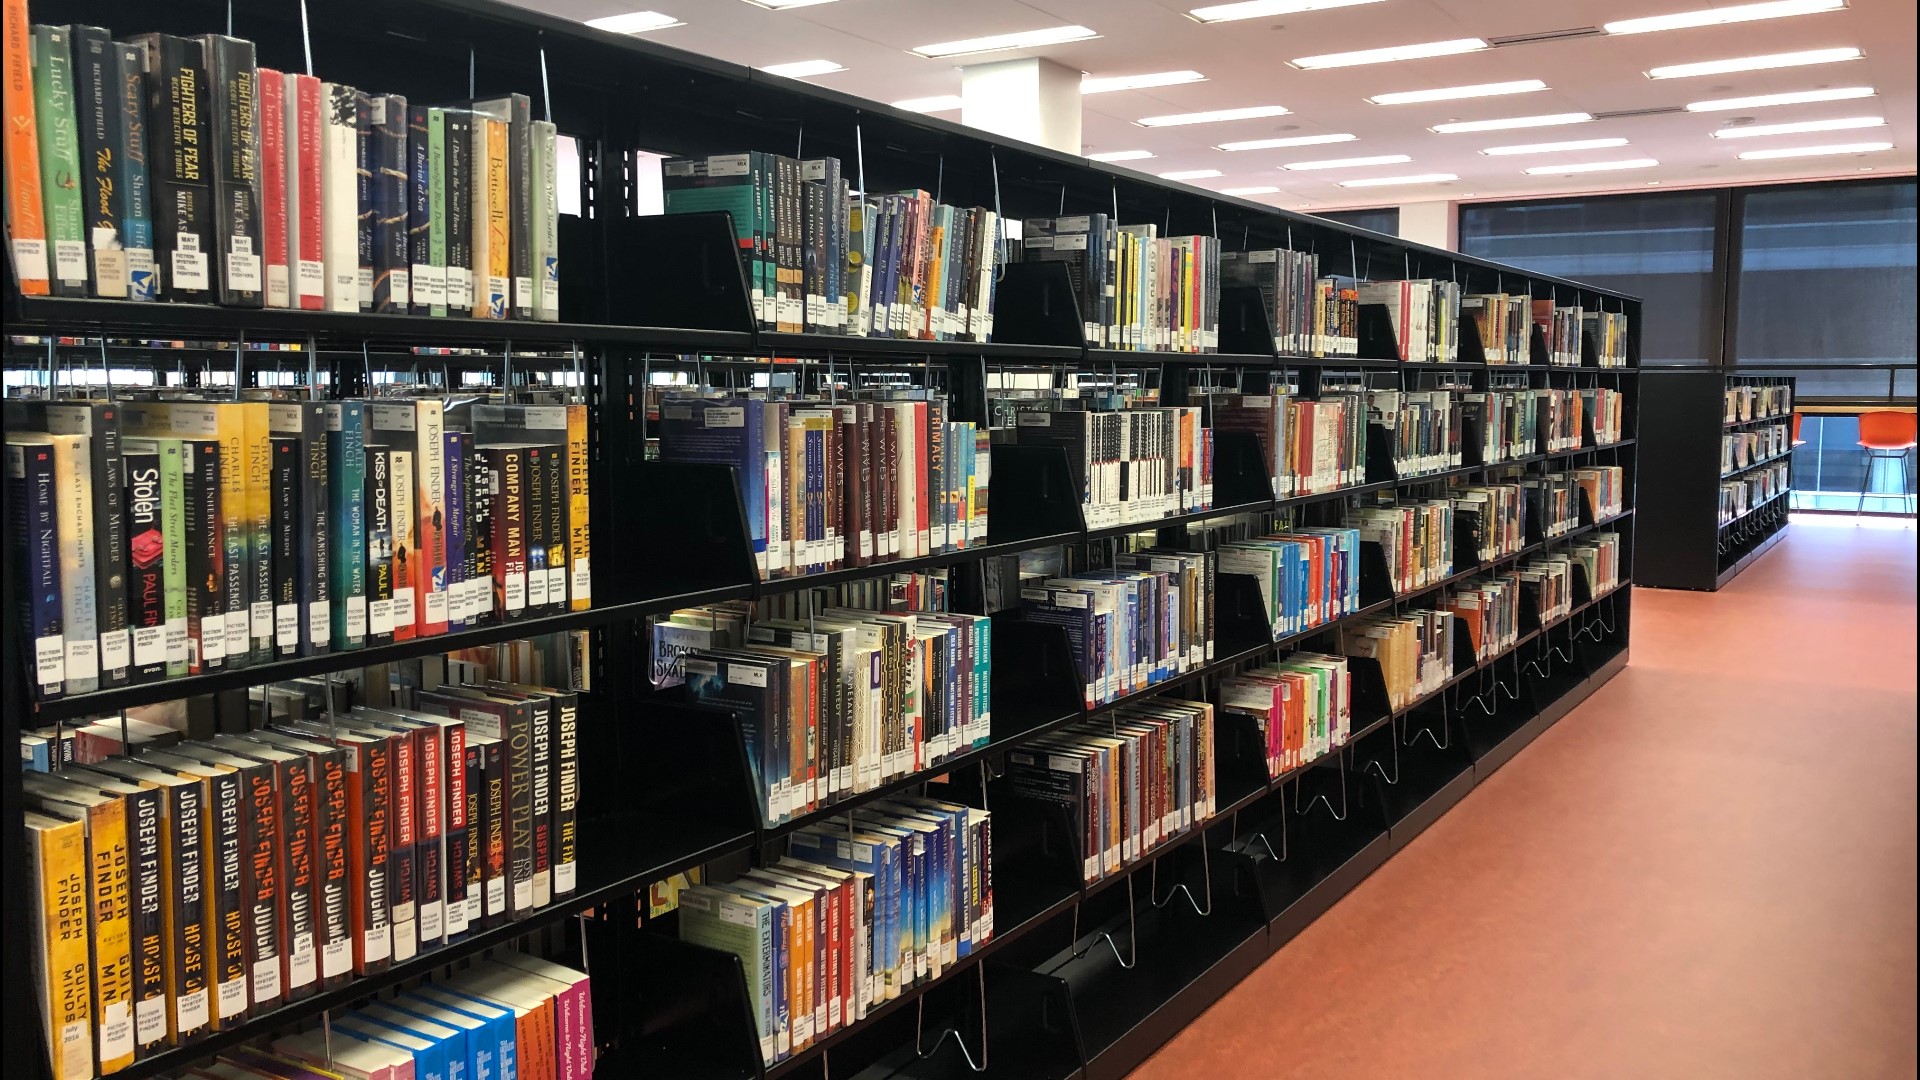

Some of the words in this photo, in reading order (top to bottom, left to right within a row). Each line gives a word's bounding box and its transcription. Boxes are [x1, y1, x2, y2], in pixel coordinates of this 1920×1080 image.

[8, 5, 20, 49] RICHARD
[12, 53, 24, 92] FIFIELD
[49, 55, 68, 113] Lucky
[92, 62, 102, 103] RICHARD
[171, 76, 179, 104] OCCULT
[123, 73, 141, 117] Scary
[180, 67, 197, 125] FIGHTERS
[238, 71, 251, 127] FIGHTERS
[53, 117, 73, 164] Stuff
[128, 121, 145, 165] Stuff
[173, 106, 182, 146] DETECTIVE
[183, 128, 198, 144] OF
[266, 107, 275, 148] beauty
[303, 108, 312, 153] beauty
[96, 147, 112, 171] The
[174, 150, 183, 179] STORIES
[184, 147, 199, 180] FEAR
[241, 148, 254, 181] FEAR
[417, 152, 425, 182] Burial
[97, 177, 114, 216] Flood
[132, 174, 144, 217] Sharon
[177, 190, 187, 217] MIKE
[234, 190, 244, 216] MIKE
[491, 157, 504, 222] Botticelli
[434, 211, 442, 235] Death
[105, 429, 116, 450] THE
[345, 430, 354, 467] FINCH
[427, 424, 439, 461] JOSEPH
[931, 407, 943, 472] PRIMACY
[106, 458, 118, 488] LAWS
[169, 471, 178, 487] The
[205, 461, 214, 482] THE
[220, 446, 230, 485] FINCH
[230, 437, 241, 493] CHARLES
[251, 445, 261, 484] FINCH
[310, 441, 319, 479] FINCH
[374, 452, 385, 480] KISS
[451, 463, 459, 496] Stranger
[571, 442, 582, 496] FINDER
[836, 443, 844, 486] WIVES
[889, 441, 897, 482] WIVES
[38, 472, 50, 506] HOME
[109, 493, 118, 507] OF
[133, 468, 159, 524] Stolen
[169, 489, 179, 510] Fleet
[351, 488, 360, 503] THE
[395, 474, 405, 506] JOSEPH
[430, 466, 441, 505] FINDER
[506, 453, 520, 522] COMPANY
[532, 464, 542, 501] JOSEPH
[550, 467, 560, 503] JOSEPH
[40, 512, 50, 523] BY
[170, 512, 180, 538] Street
[206, 487, 216, 559] INHERITANCE
[228, 516, 238, 532] THE
[317, 511, 325, 527] THE
[352, 506, 361, 537] WOMAN
[375, 488, 387, 533] DEATH
[396, 510, 406, 542] FINDER
[533, 504, 543, 541] FINDER
[551, 506, 561, 542] FINDER
[76, 497, 85, 568] ENCHANTMENTS
[109, 513, 120, 563] MURDER
[228, 536, 239, 560] LAST
[508, 527, 521, 557] MAN
[41, 529, 53, 588] NIGHTFALL
[170, 539, 180, 576] Murders
[317, 531, 326, 579] VANISHING
[353, 550, 361, 564] THE
[142, 573, 157, 608] PAUL
[229, 562, 240, 611] PASSENGE
[317, 582, 326, 601] MAN
[353, 567, 361, 594] WATER
[378, 564, 388, 591] PAUL
[74, 585, 83, 624] FINCH
[83, 576, 93, 632] CHARLES
[534, 709, 549, 763] JOSEPH
[561, 706, 576, 759] JOSEPH
[399, 744, 410, 793] JOSEPH
[424, 736, 435, 786] JOSEPH
[451, 728, 462, 777] JOSEPH
[511, 721, 529, 800] POWER
[452, 780, 462, 826] FINDER
[489, 779, 501, 816] JOSEPH
[534, 766, 549, 816] FINDER
[561, 763, 575, 812] FINDER
[138, 799, 156, 856] JOSEPH
[180, 791, 197, 847] JOSEPH
[221, 781, 237, 836] JOSEPH
[400, 795, 411, 843] FINDER
[426, 788, 437, 835] FINDER
[467, 793, 477, 824] JOSEPH
[512, 804, 531, 851] PLAY
[468, 827, 478, 859] FINDER
[490, 818, 502, 856] FINDER
[562, 820, 574, 843] THE
[114, 844, 128, 920] JOSEPH
[182, 850, 199, 903] FINDER
[223, 840, 239, 891] FINDER
[97, 852, 113, 923] FINDER
[141, 859, 158, 914] FINDER
[57, 879, 71, 941] FINDER
[70, 873, 82, 940] JOSEPH
[761, 911, 770, 929] THE
[185, 923, 200, 971] HOUSE
[225, 911, 242, 958] HOUSE
[143, 935, 160, 985] HOUSE
[762, 931, 771, 997] EXTERMINATORS
[62, 970, 76, 1024] MINDS
[75, 963, 87, 1021] GUILTY
[578, 991, 587, 1025] Welcome
[578, 1034, 588, 1056] Night
[579, 1056, 588, 1075] Vale
